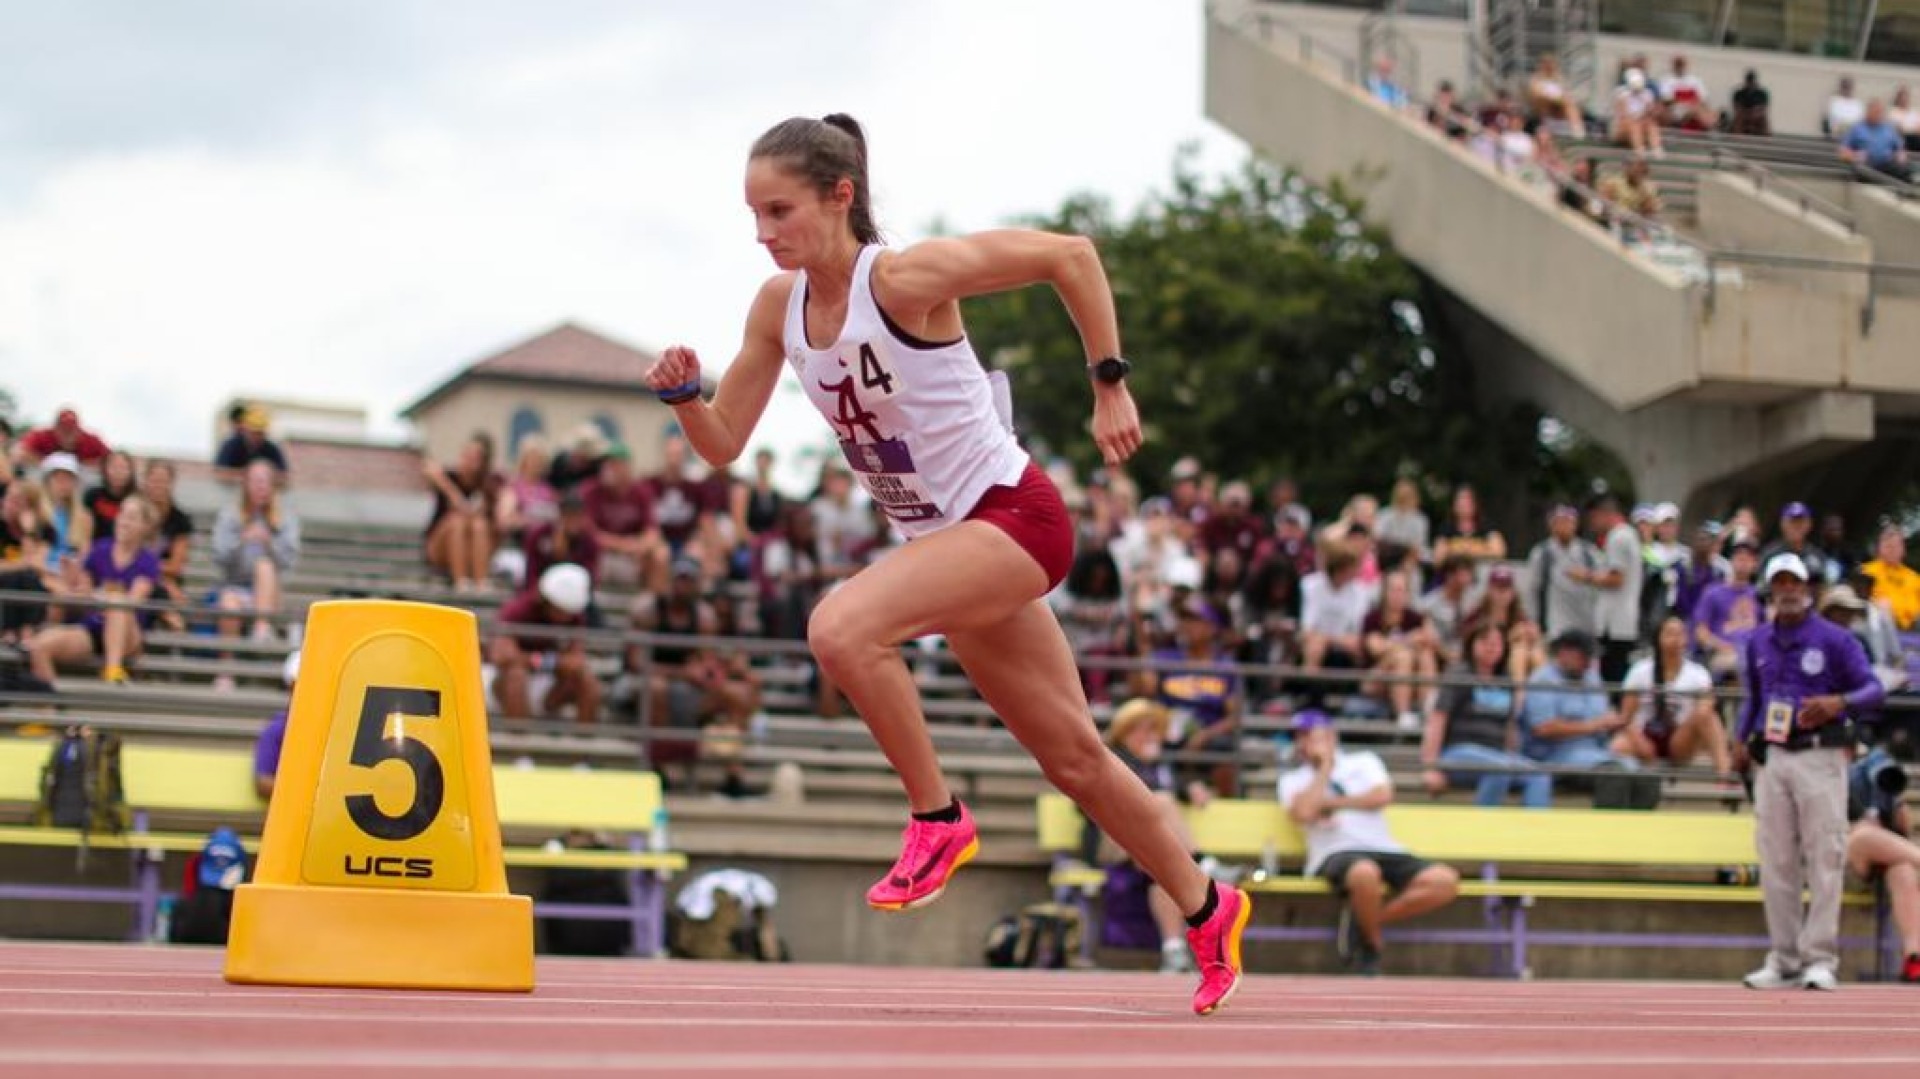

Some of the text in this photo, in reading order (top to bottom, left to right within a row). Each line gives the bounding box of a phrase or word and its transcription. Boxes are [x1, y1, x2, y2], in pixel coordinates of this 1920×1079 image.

[860, 342, 892, 395] 4
[818, 374, 896, 445] A
[344, 684, 444, 841] 5
[344, 854, 434, 879] UCS
